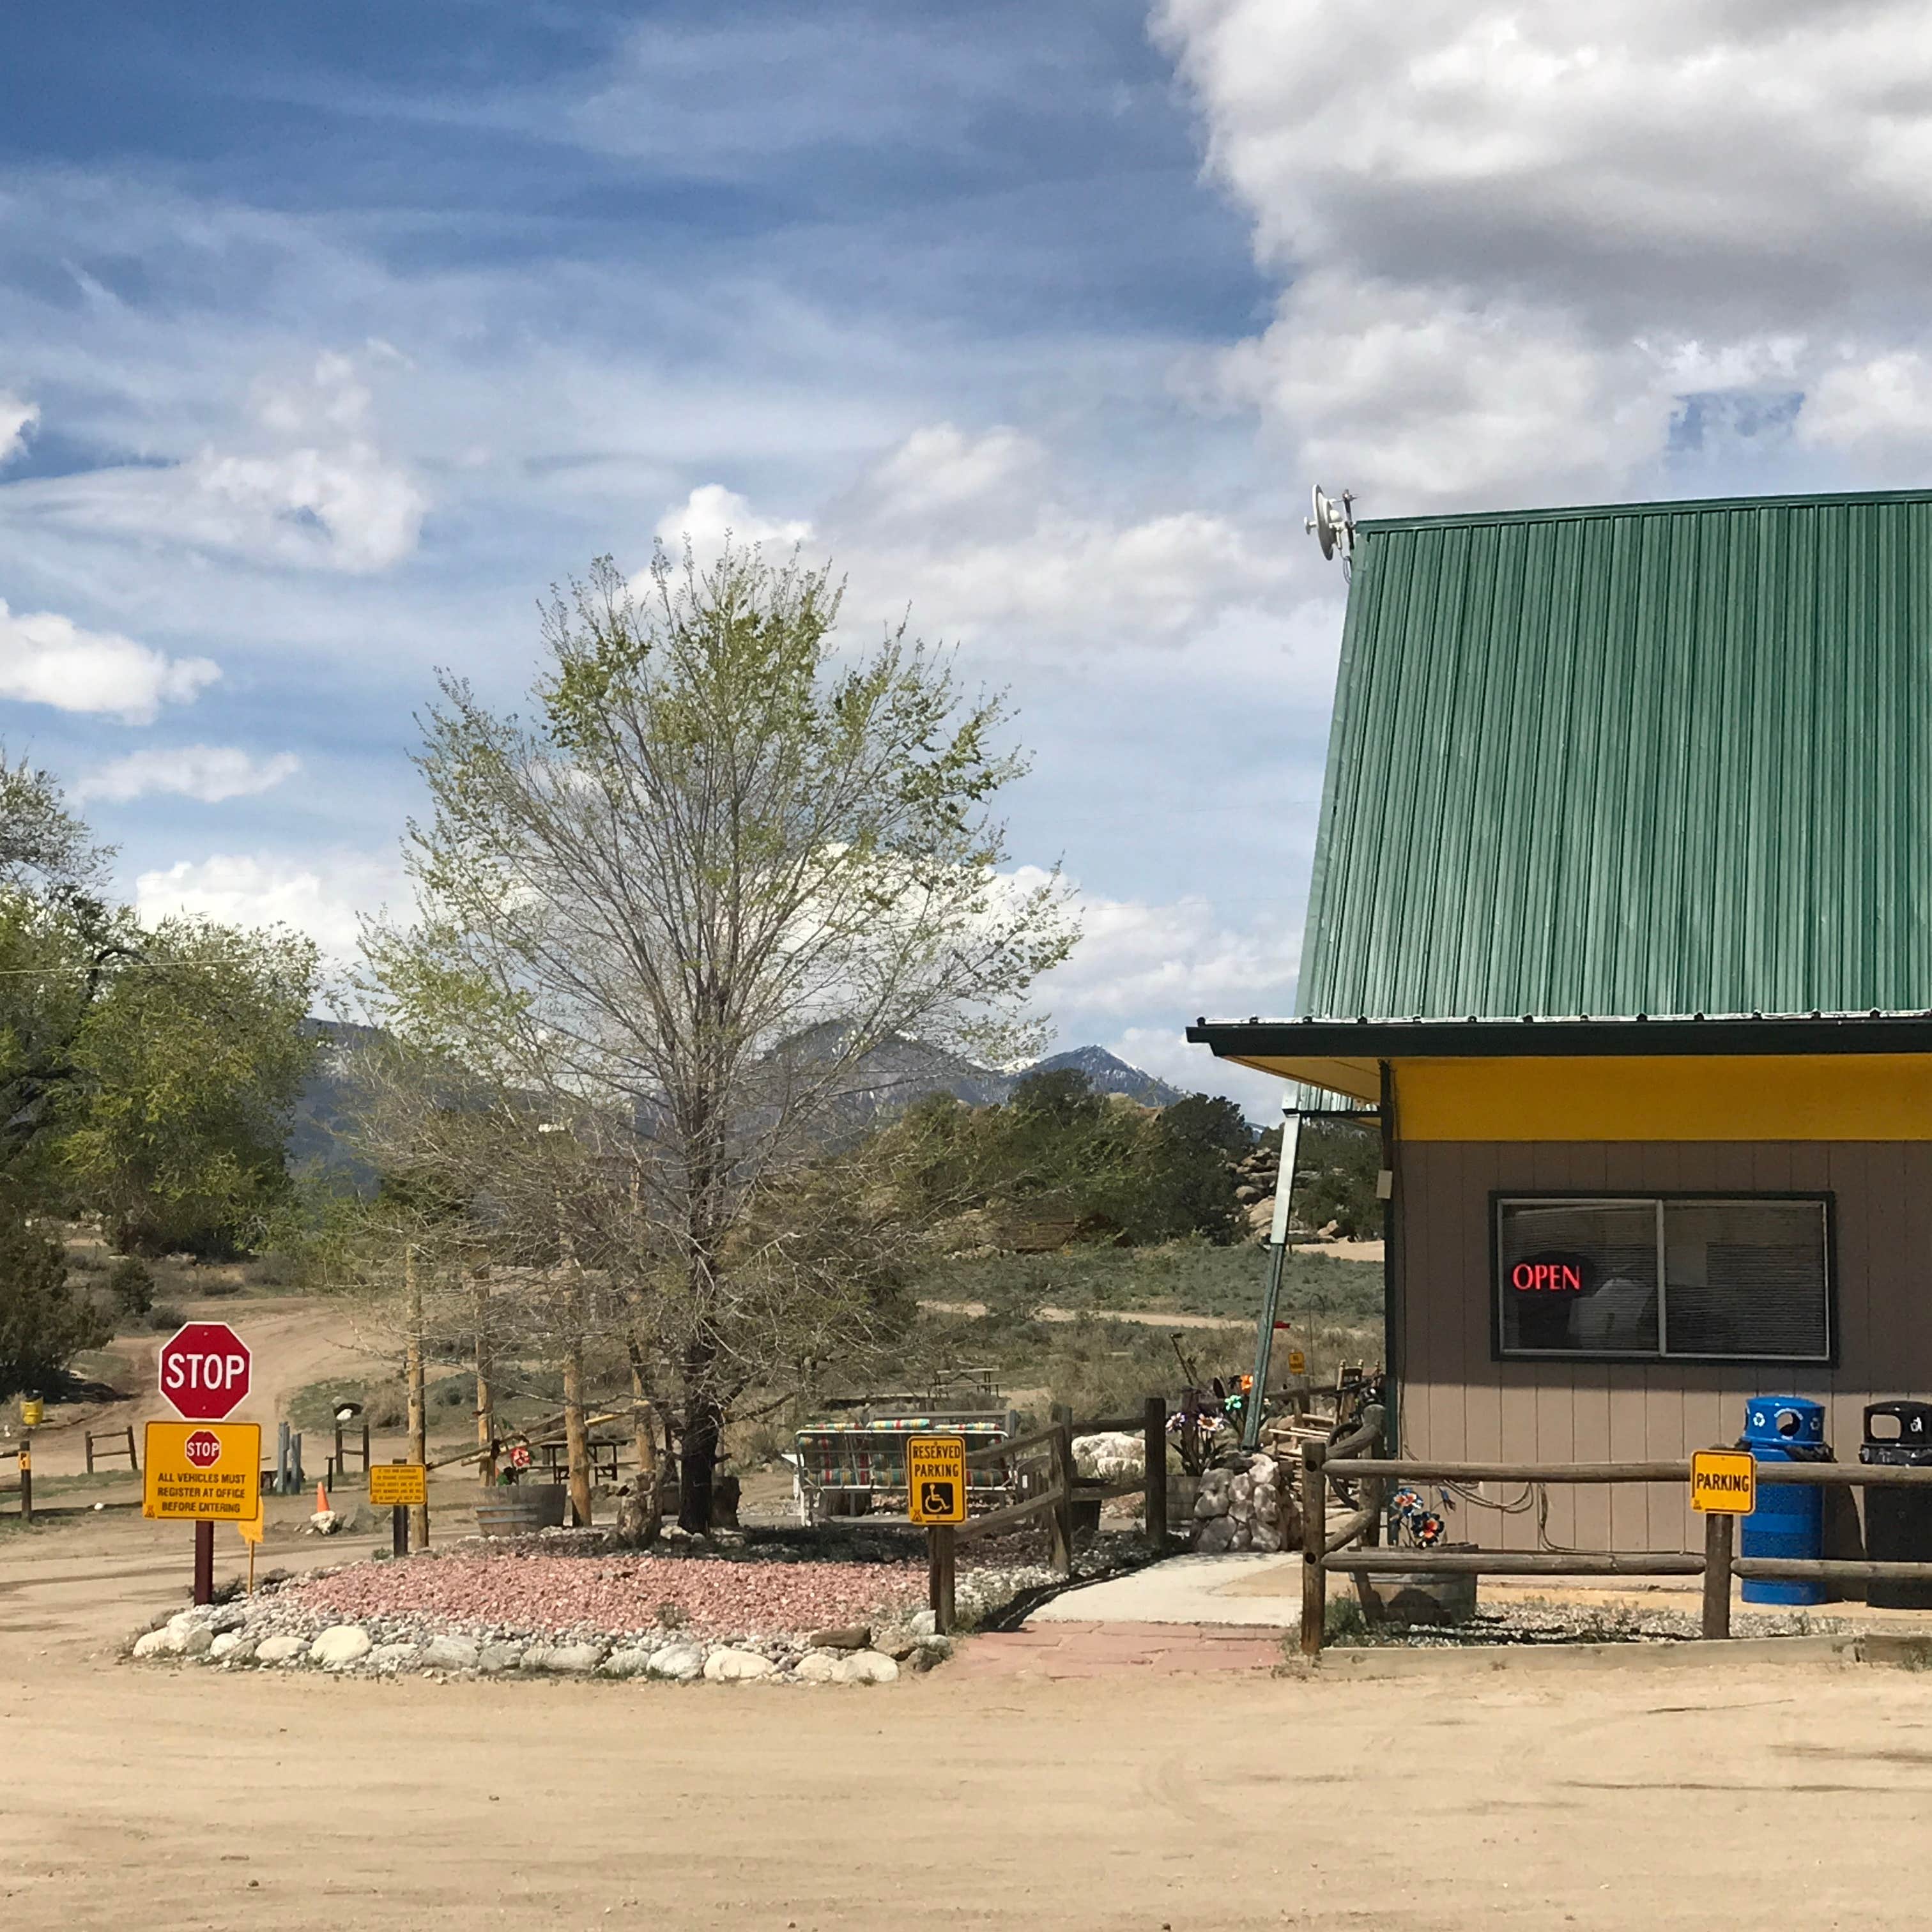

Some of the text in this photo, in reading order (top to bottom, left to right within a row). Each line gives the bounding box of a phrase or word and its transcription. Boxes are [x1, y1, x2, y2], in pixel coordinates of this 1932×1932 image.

[1513, 1264, 1580, 1290] OPEN
[166, 1353, 245, 1390] STOP
[187, 1442, 219, 1457] STOP
[913, 1445, 961, 1459] RESERVED
[914, 1464, 959, 1477] PARKING
[158, 1473, 245, 1483] ALL VEHICLES MUST
[1696, 1473, 1749, 1492] PARKING
[158, 1487, 245, 1498] REGISTER AT OFFICE
[162, 1502, 240, 1513] BEFORE ENTERING
